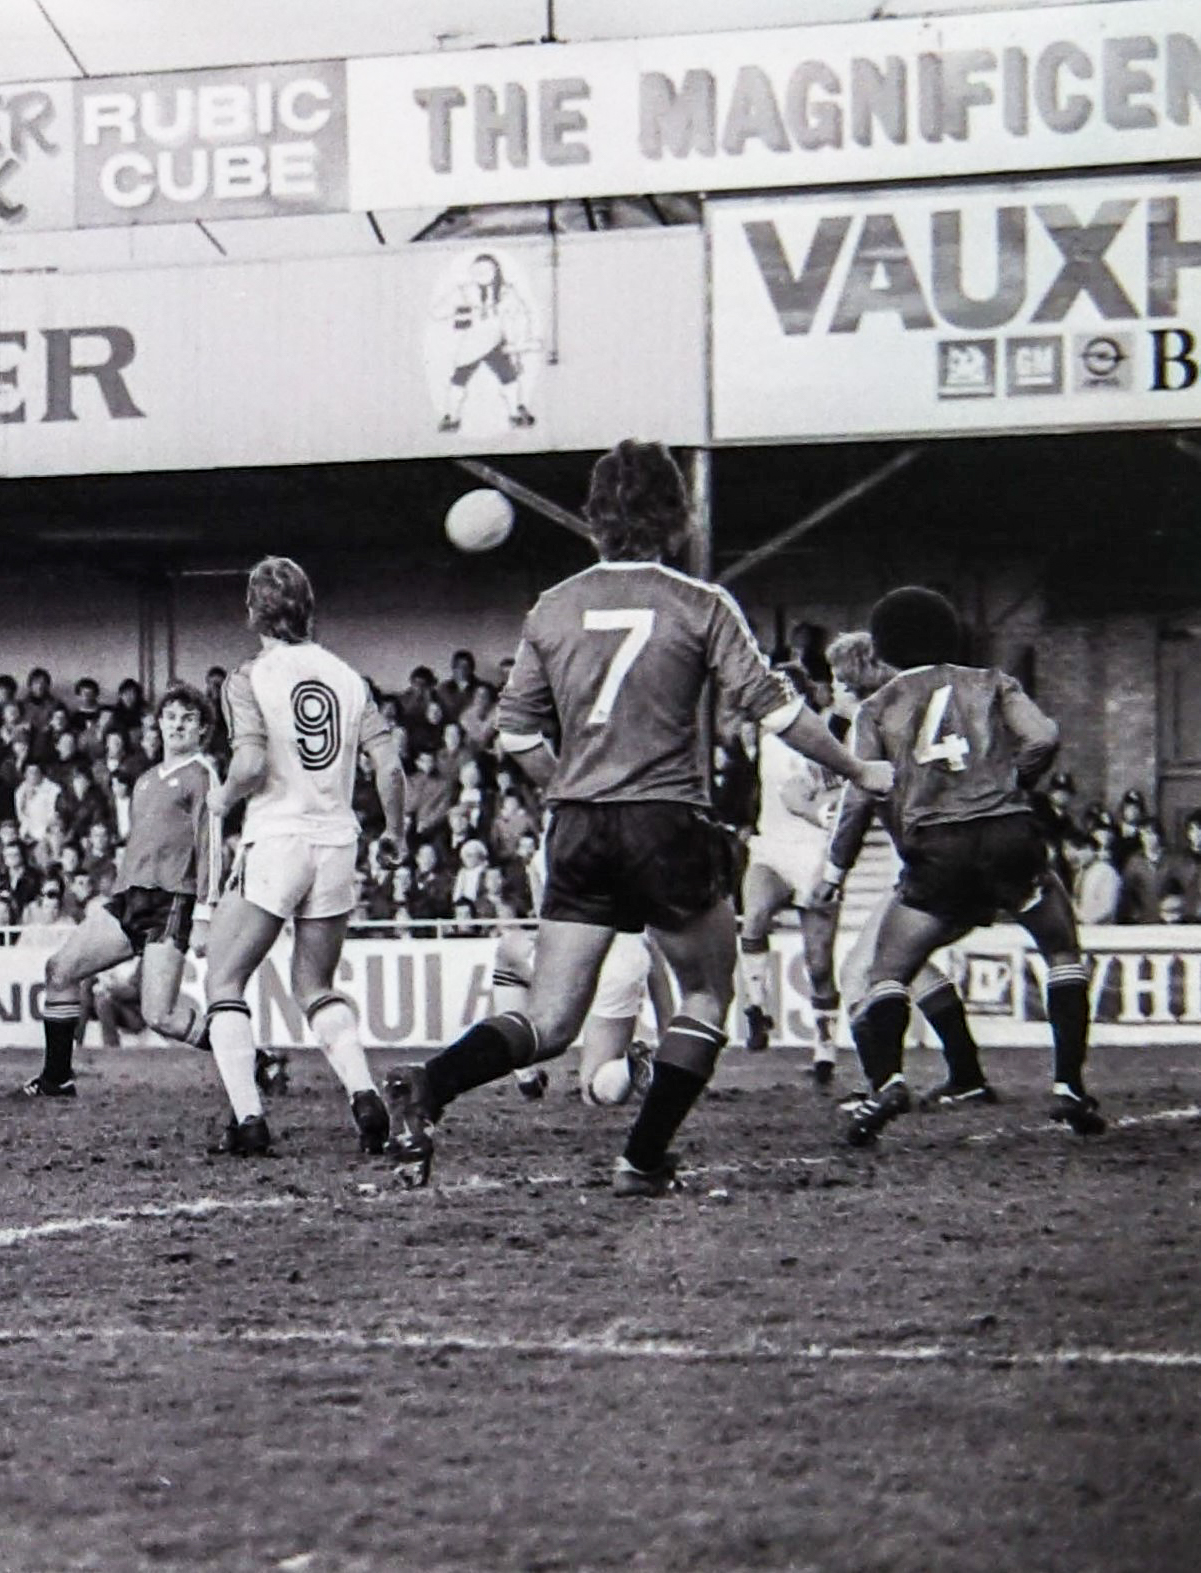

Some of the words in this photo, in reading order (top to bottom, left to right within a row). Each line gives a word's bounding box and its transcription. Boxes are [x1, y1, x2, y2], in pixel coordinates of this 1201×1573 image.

[82, 79, 332, 145] RUBIC
[413, 77, 591, 174] THE
[639, 33, 1201, 159] MAGNIFICEN
[100, 141, 318, 208] CUBE
[742, 197, 1201, 335] VAUXH
[582, 609, 656, 723] 7
[291, 680, 341, 771] 9
[913, 685, 969, 771] 4
